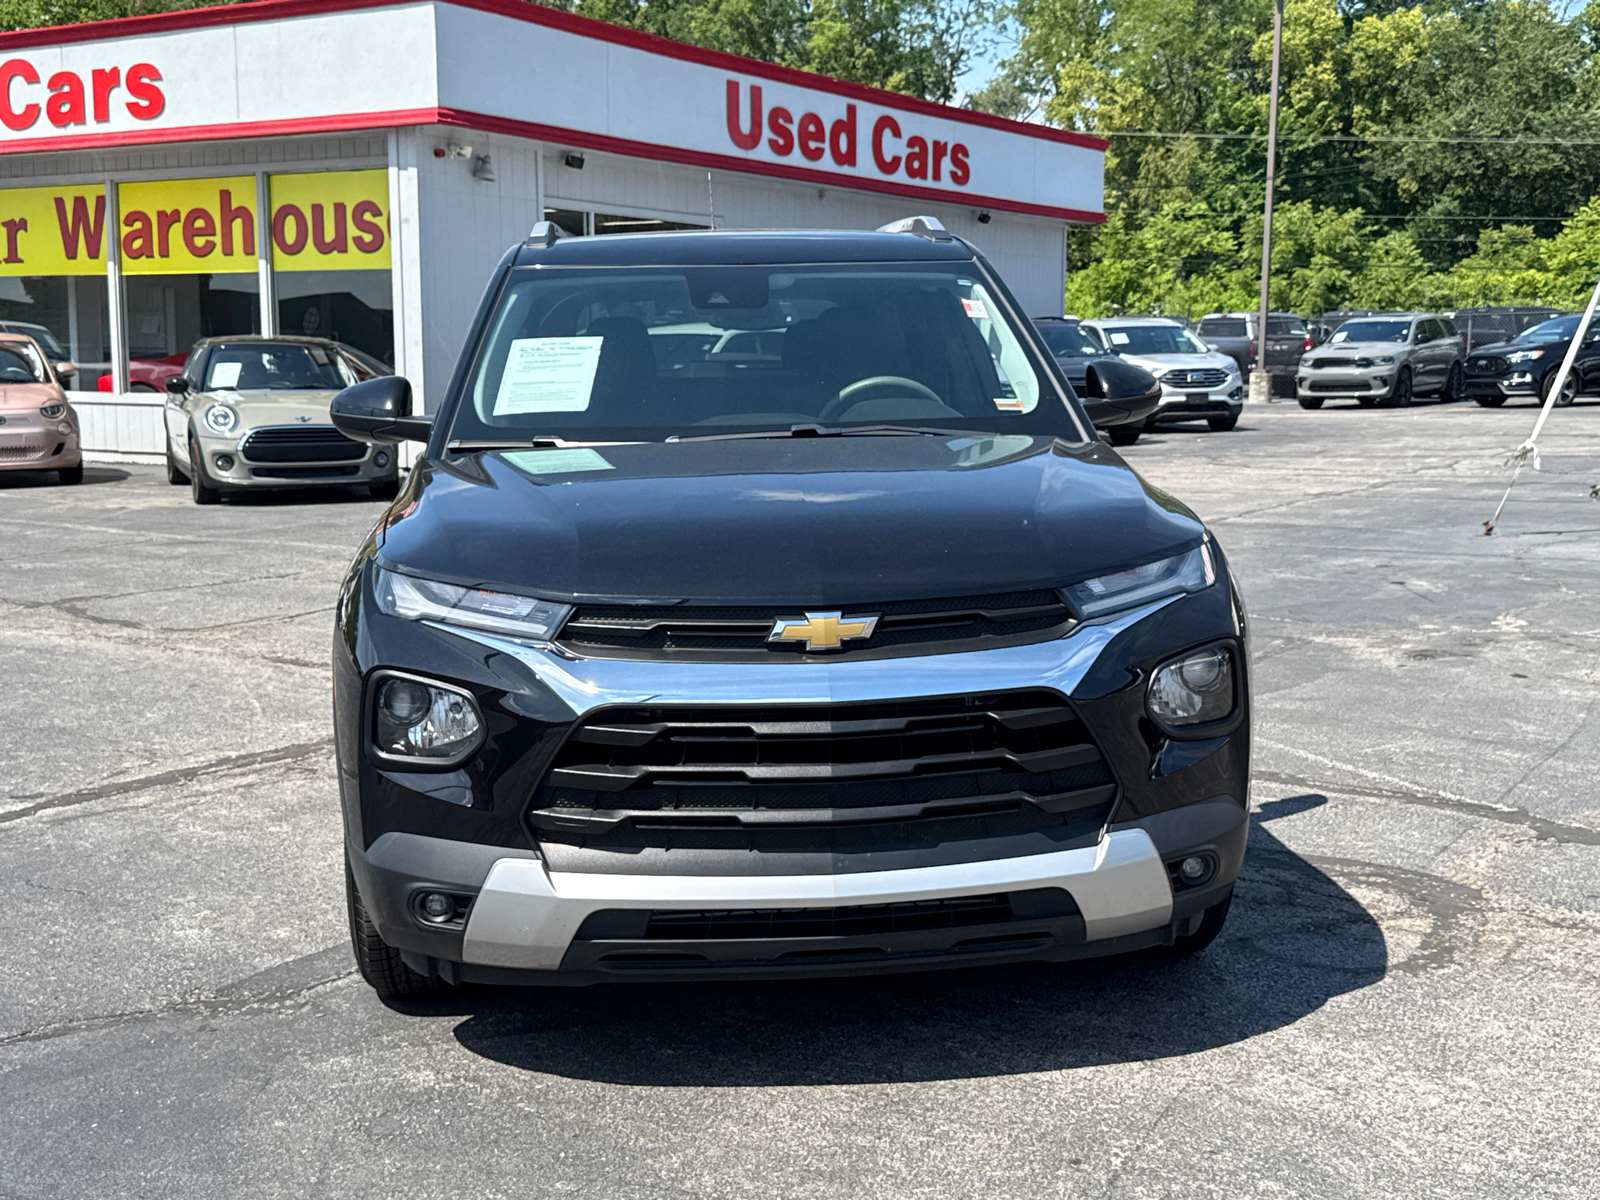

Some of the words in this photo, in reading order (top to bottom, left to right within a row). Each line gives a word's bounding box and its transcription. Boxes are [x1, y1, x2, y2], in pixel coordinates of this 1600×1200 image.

[0, 58, 165, 131] Cars
[726, 80, 857, 167] Used
[872, 115, 970, 186] Cars
[0, 217, 28, 264] r
[54, 189, 391, 261] Warehous
